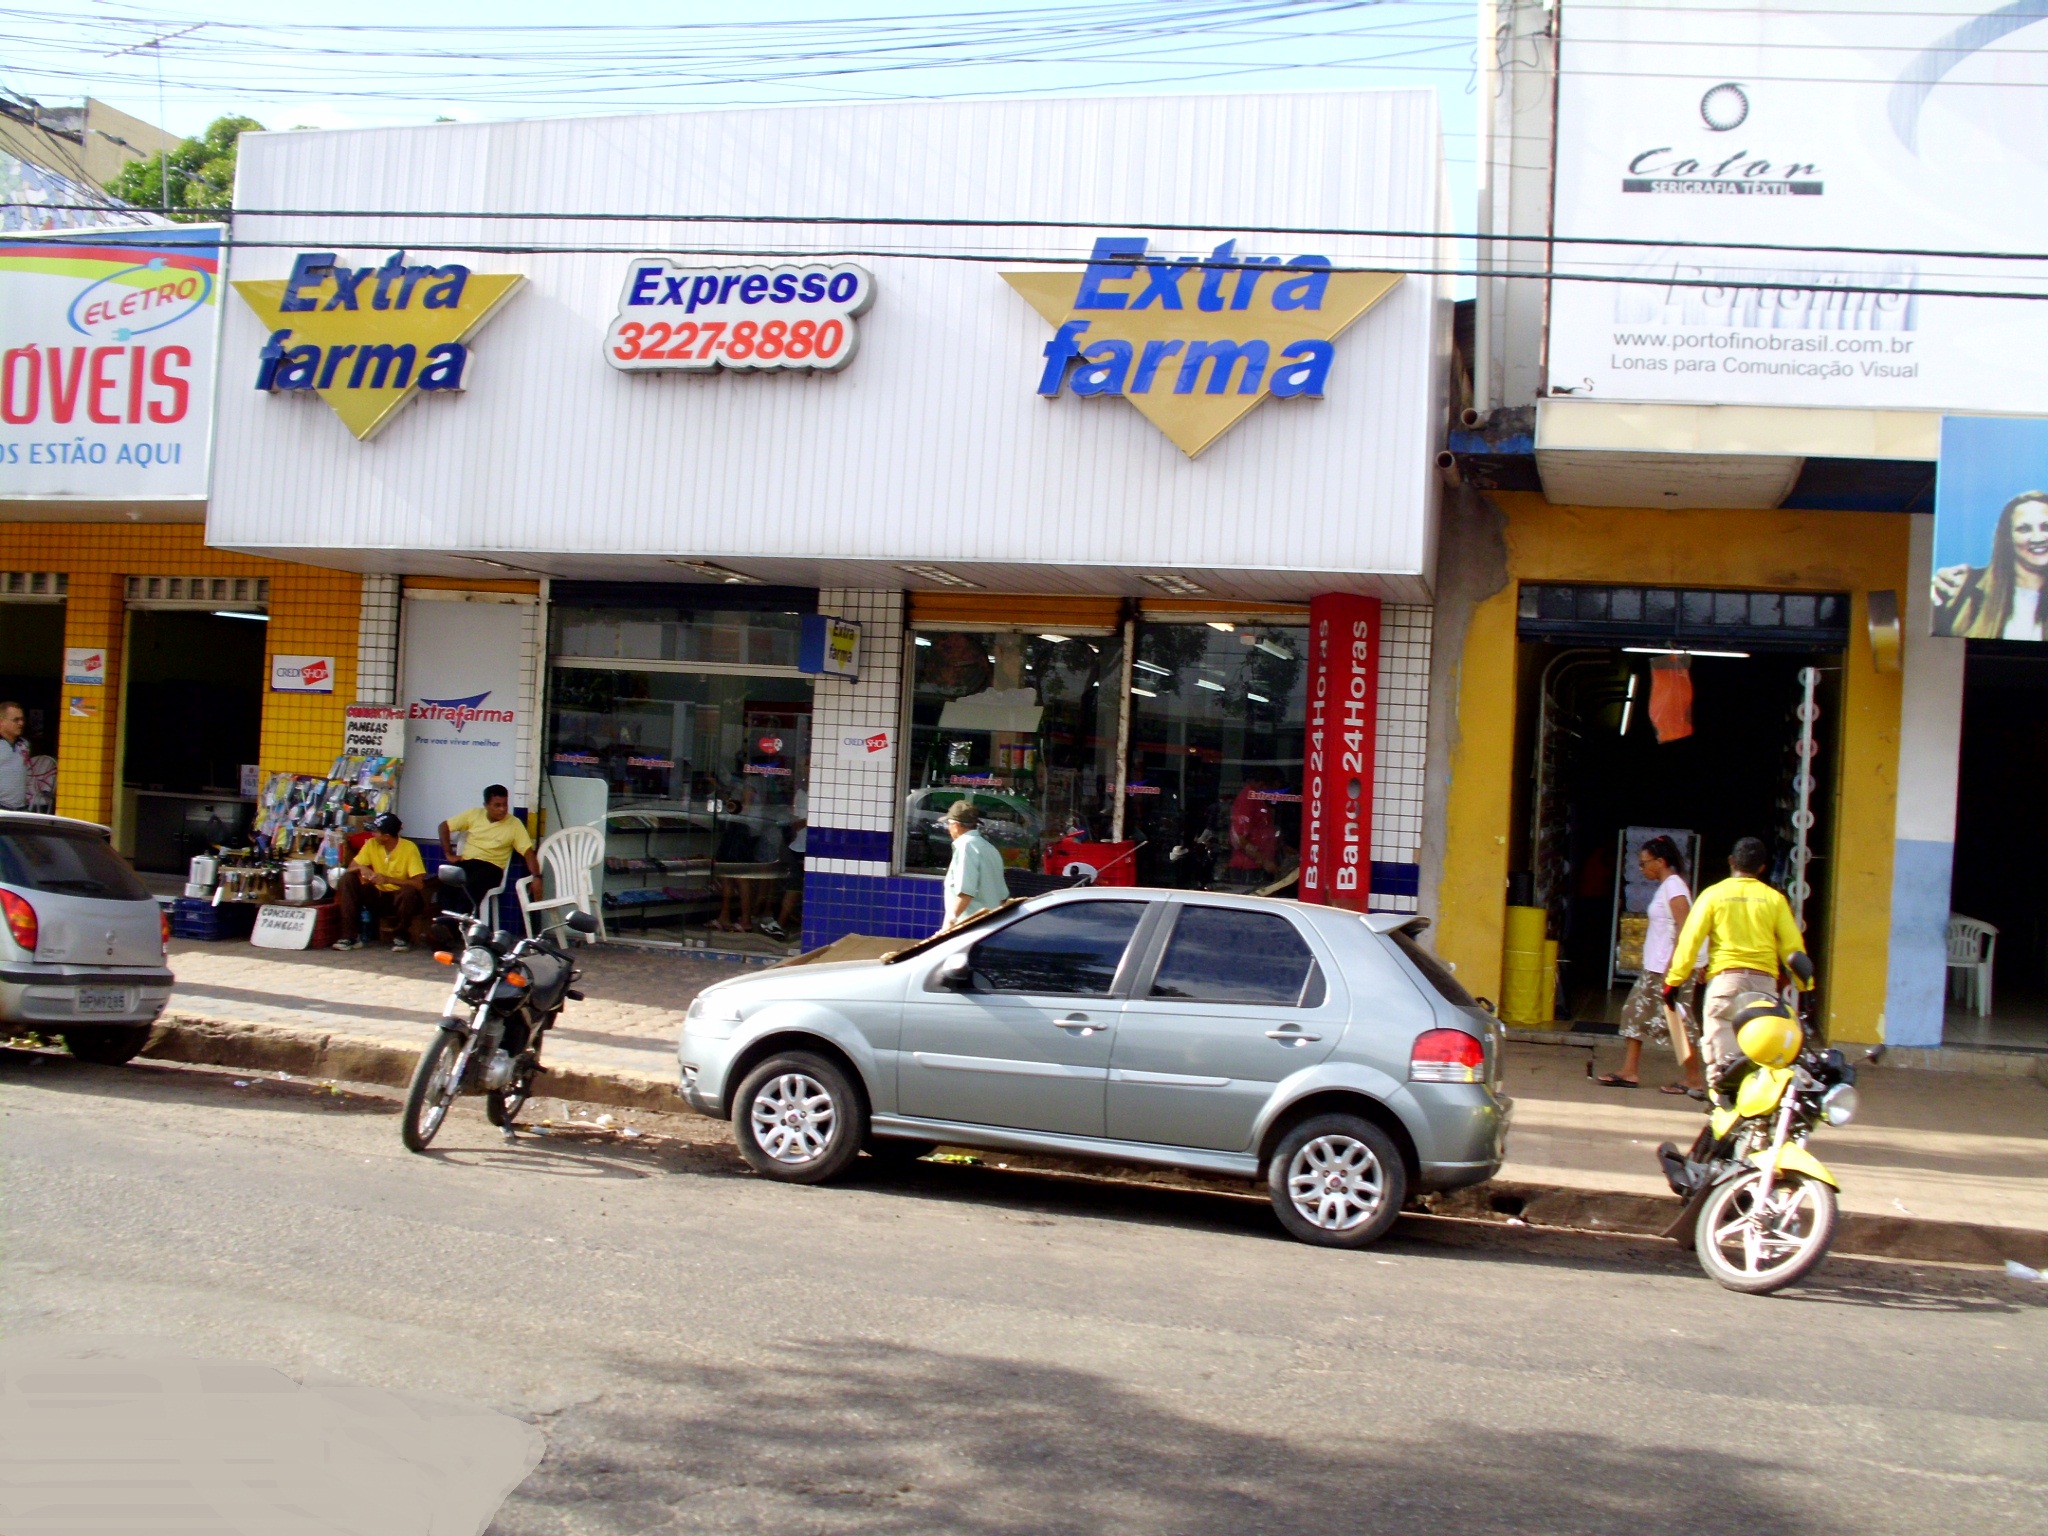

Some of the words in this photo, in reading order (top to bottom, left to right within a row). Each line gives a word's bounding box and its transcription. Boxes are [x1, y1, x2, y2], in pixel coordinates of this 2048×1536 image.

[1651, 181, 1738, 194] SERIGRAFIA
[279, 250, 471, 312] Extra
[628, 267, 858, 316] Expresso
[1073, 237, 1335, 310] Extra
[84, 276, 197, 325] ELETRO
[612, 319, 844, 361] 3227-8880
[1613, 332, 1914, 354] www.portofinobrasil.com.br
[255, 329, 468, 391] farma
[1037, 321, 1335, 398] farma
[1611, 354, 1668, 371] Lonas
[1674, 361, 1716, 374] para
[1722, 357, 1854, 380] Comunicação
[1860, 360, 1919, 378] Visual
[0, 343, 191, 425] ÓVEIS
[29, 437, 107, 464] ESTÃO
[116, 443, 182, 468] AQUI
[347, 721, 388, 733] PANELAS
[408, 702, 515, 729] Extrafarma
[414, 736, 429, 744] Pra
[449, 737, 470, 746] viver
[472, 738, 500, 747] melhor
[262, 908, 306, 919] CONSERTA
